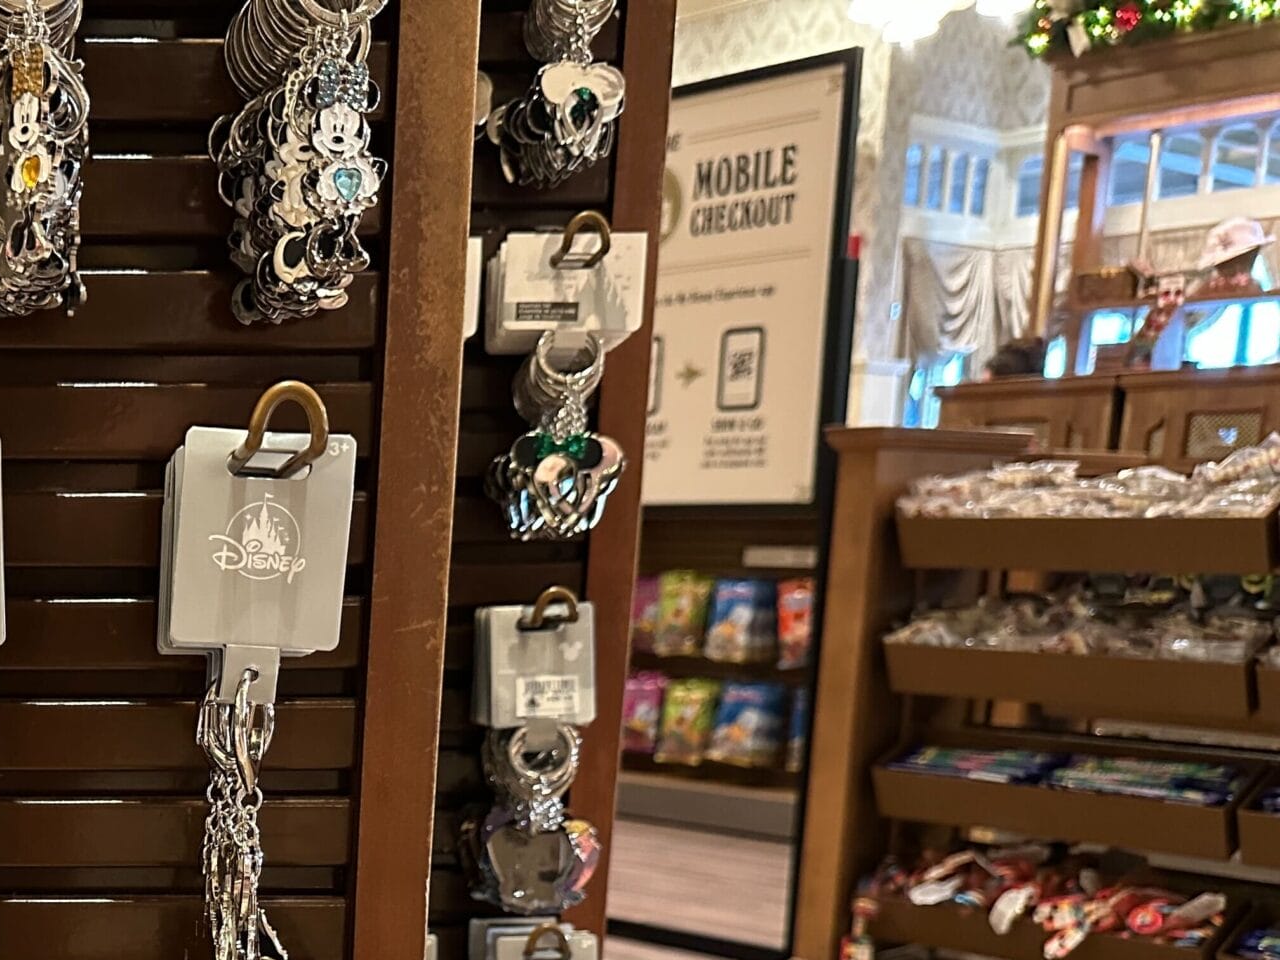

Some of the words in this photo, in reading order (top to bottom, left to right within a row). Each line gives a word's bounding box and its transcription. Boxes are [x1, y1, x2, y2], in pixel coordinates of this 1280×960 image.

[691, 143, 798, 201] MOBILE
[689, 193, 796, 237] CHECKOUT
[328, 441, 350, 456] 3+
